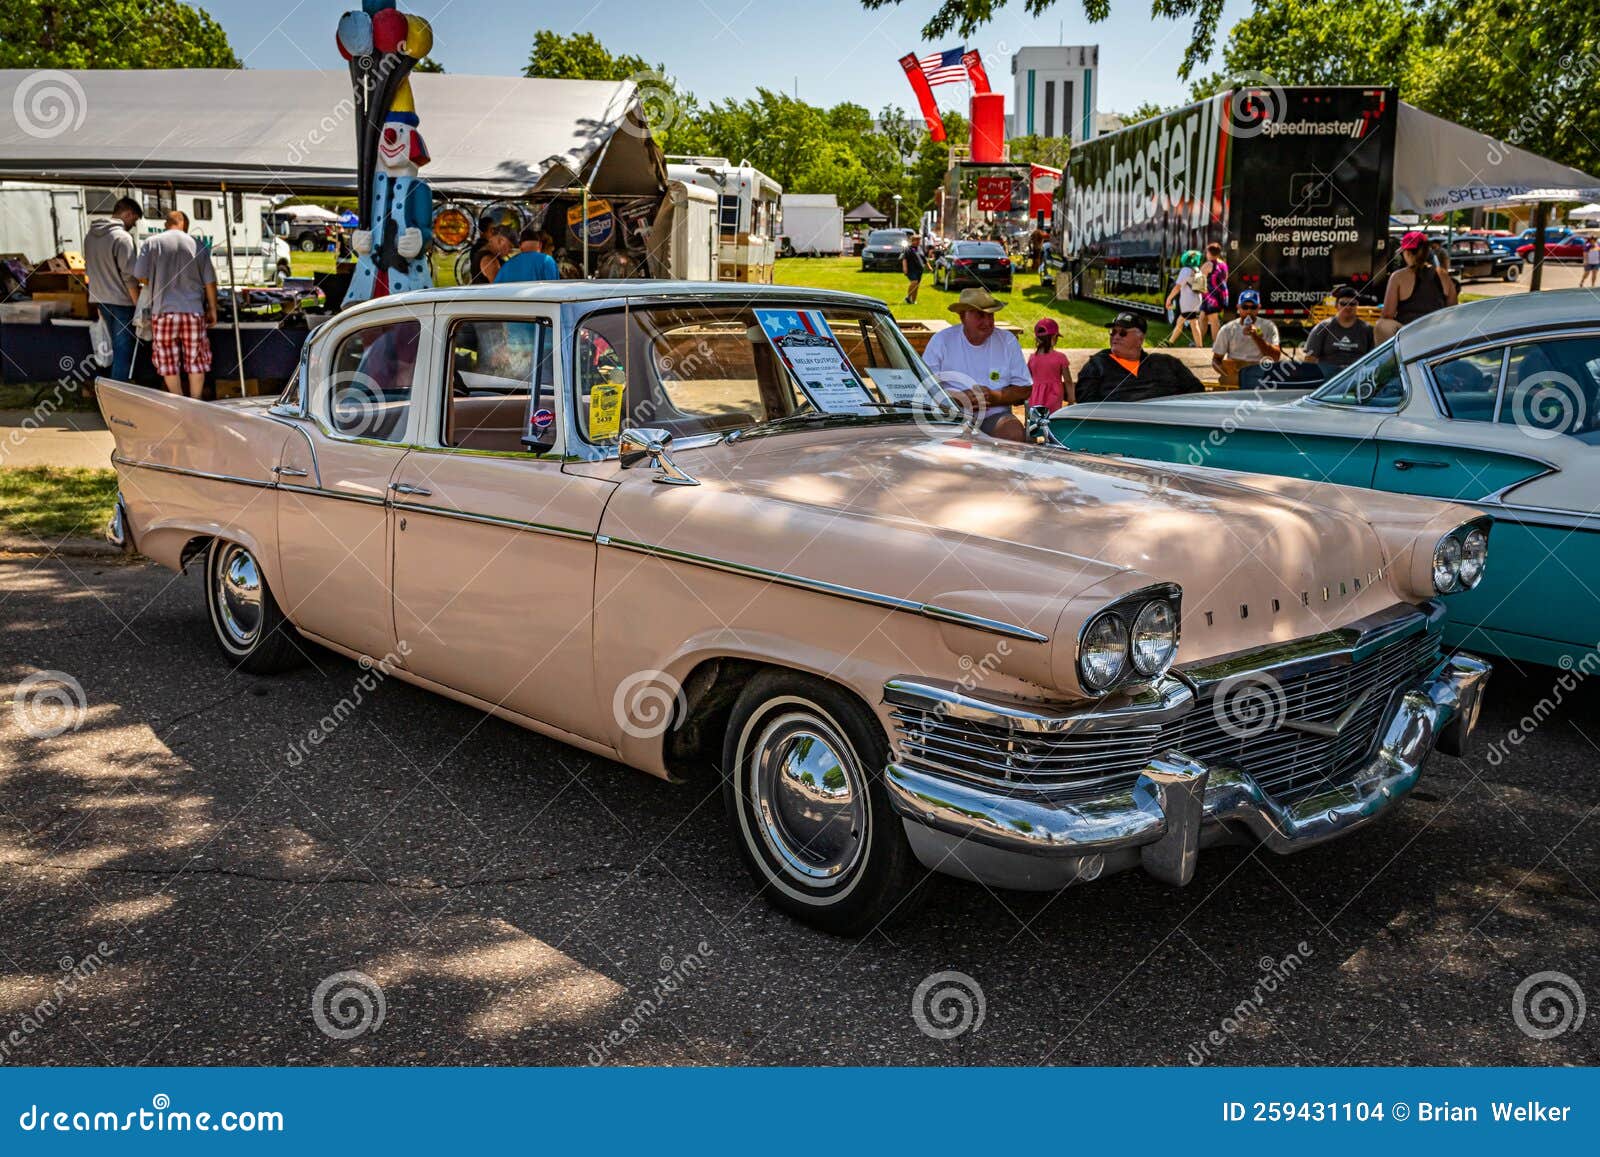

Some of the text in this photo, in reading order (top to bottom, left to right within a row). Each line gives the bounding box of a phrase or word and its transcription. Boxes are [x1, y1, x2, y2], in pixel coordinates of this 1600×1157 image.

[1335, 215, 1355, 228] just
[1256, 230, 1359, 243] makes awesome
[1282, 247, 1300, 257] car
